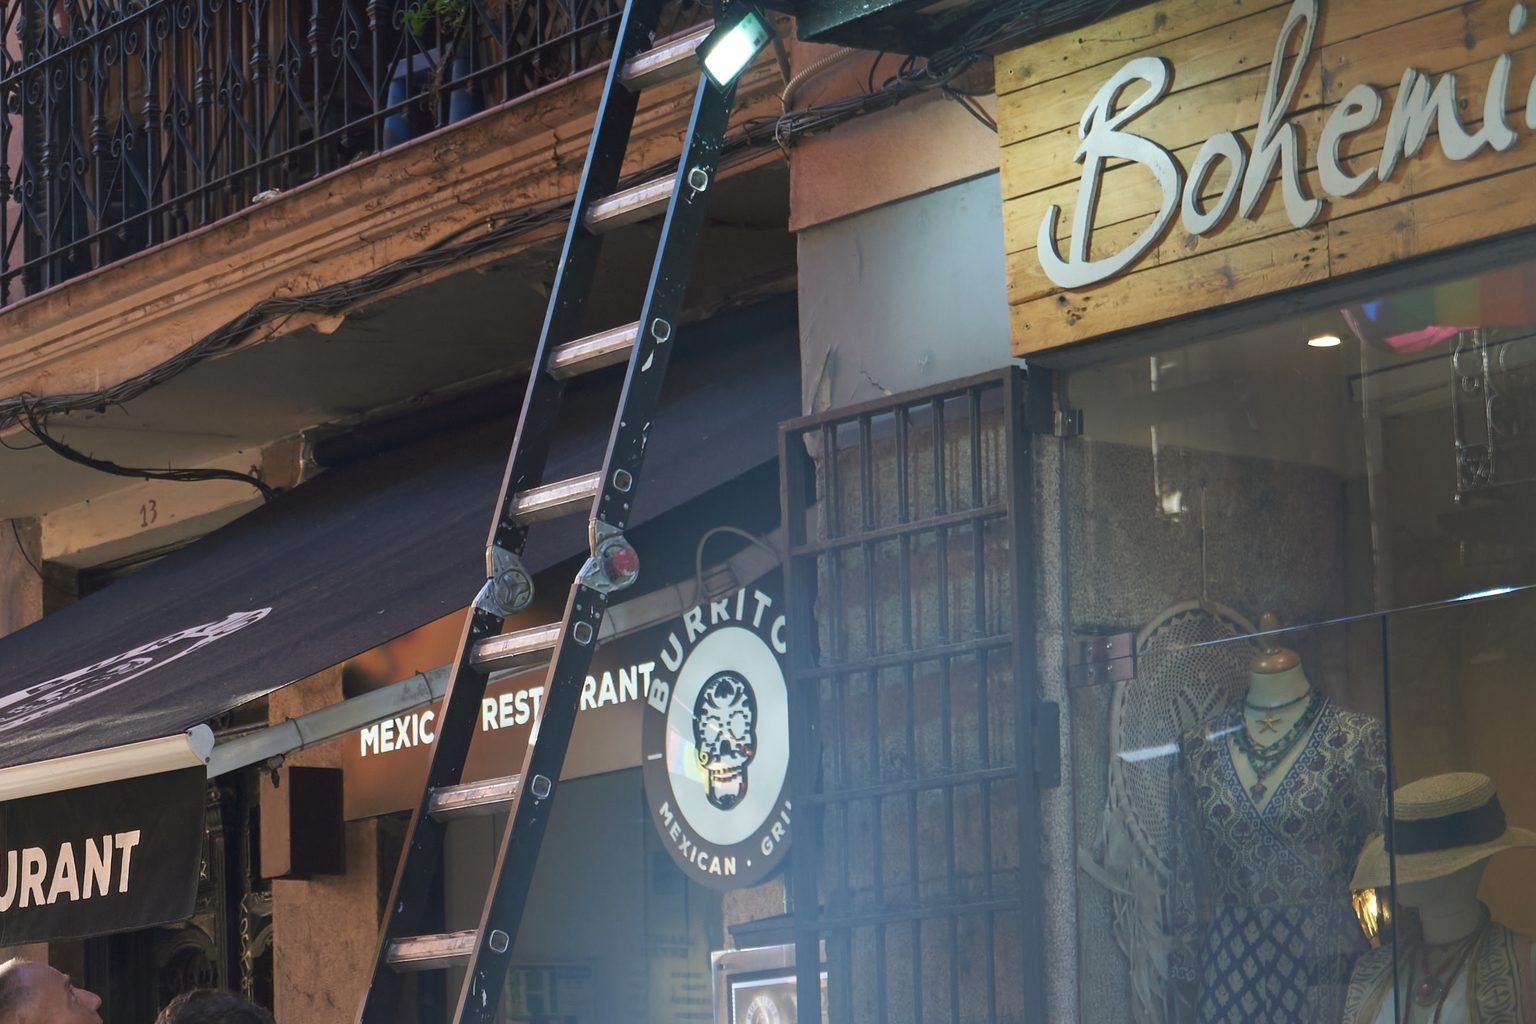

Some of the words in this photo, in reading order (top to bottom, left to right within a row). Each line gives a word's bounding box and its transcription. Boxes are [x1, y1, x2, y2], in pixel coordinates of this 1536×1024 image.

[1037, 0, 1536, 289] Bohemi
[659, 801, 736, 876] MEXICAN
[760, 800, 792, 856] GRI
